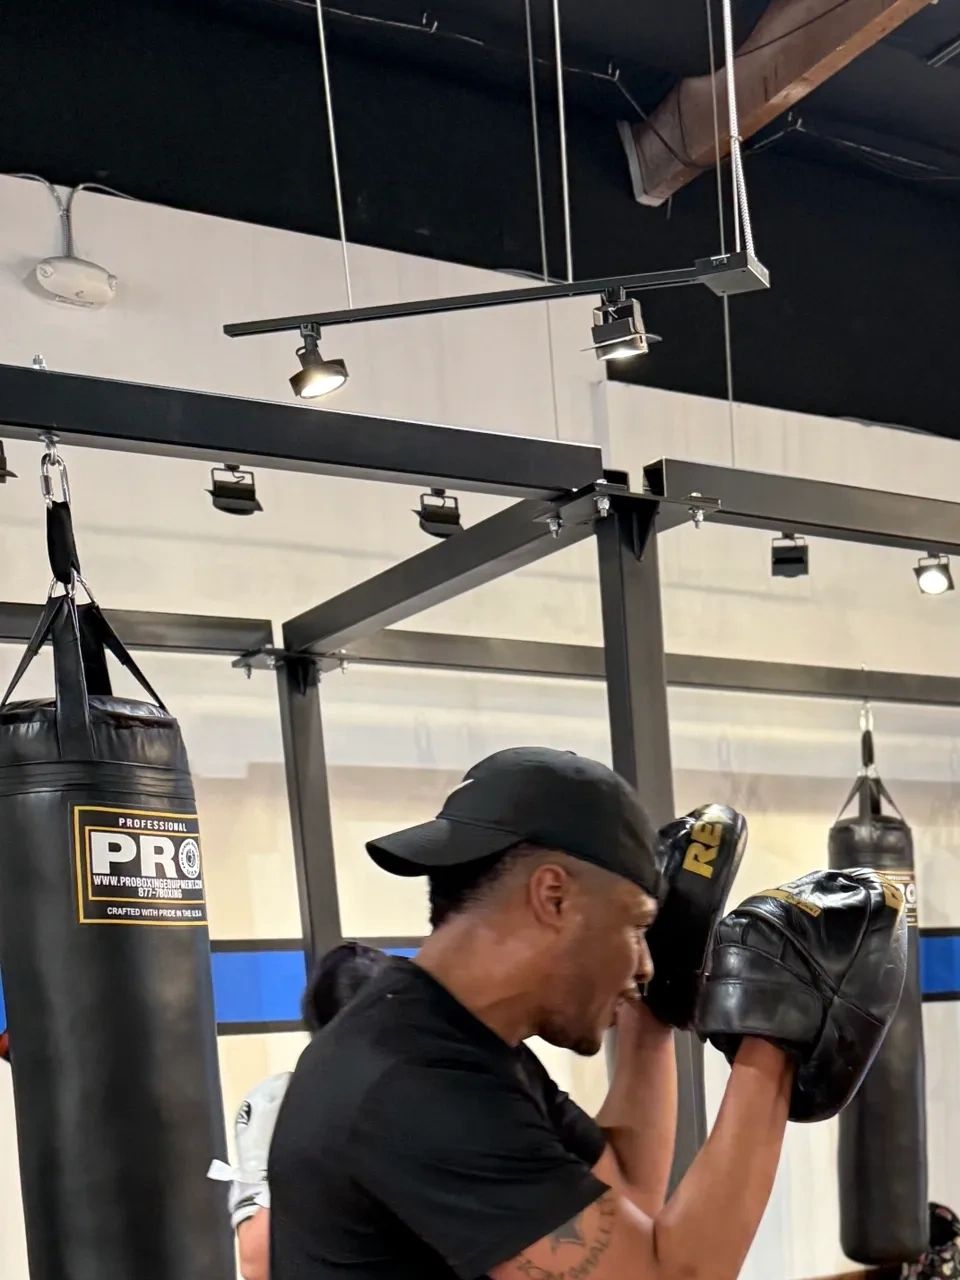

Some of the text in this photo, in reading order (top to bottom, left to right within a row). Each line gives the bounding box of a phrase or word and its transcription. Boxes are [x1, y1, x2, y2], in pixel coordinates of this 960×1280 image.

[118, 817, 187, 832] PROFESSIONAL
[90, 831, 200, 879] PRO
[107, 906, 141, 917] CRAFTED
[142, 908, 159, 917] WITH
[159, 909, 176, 918] PRIDE
